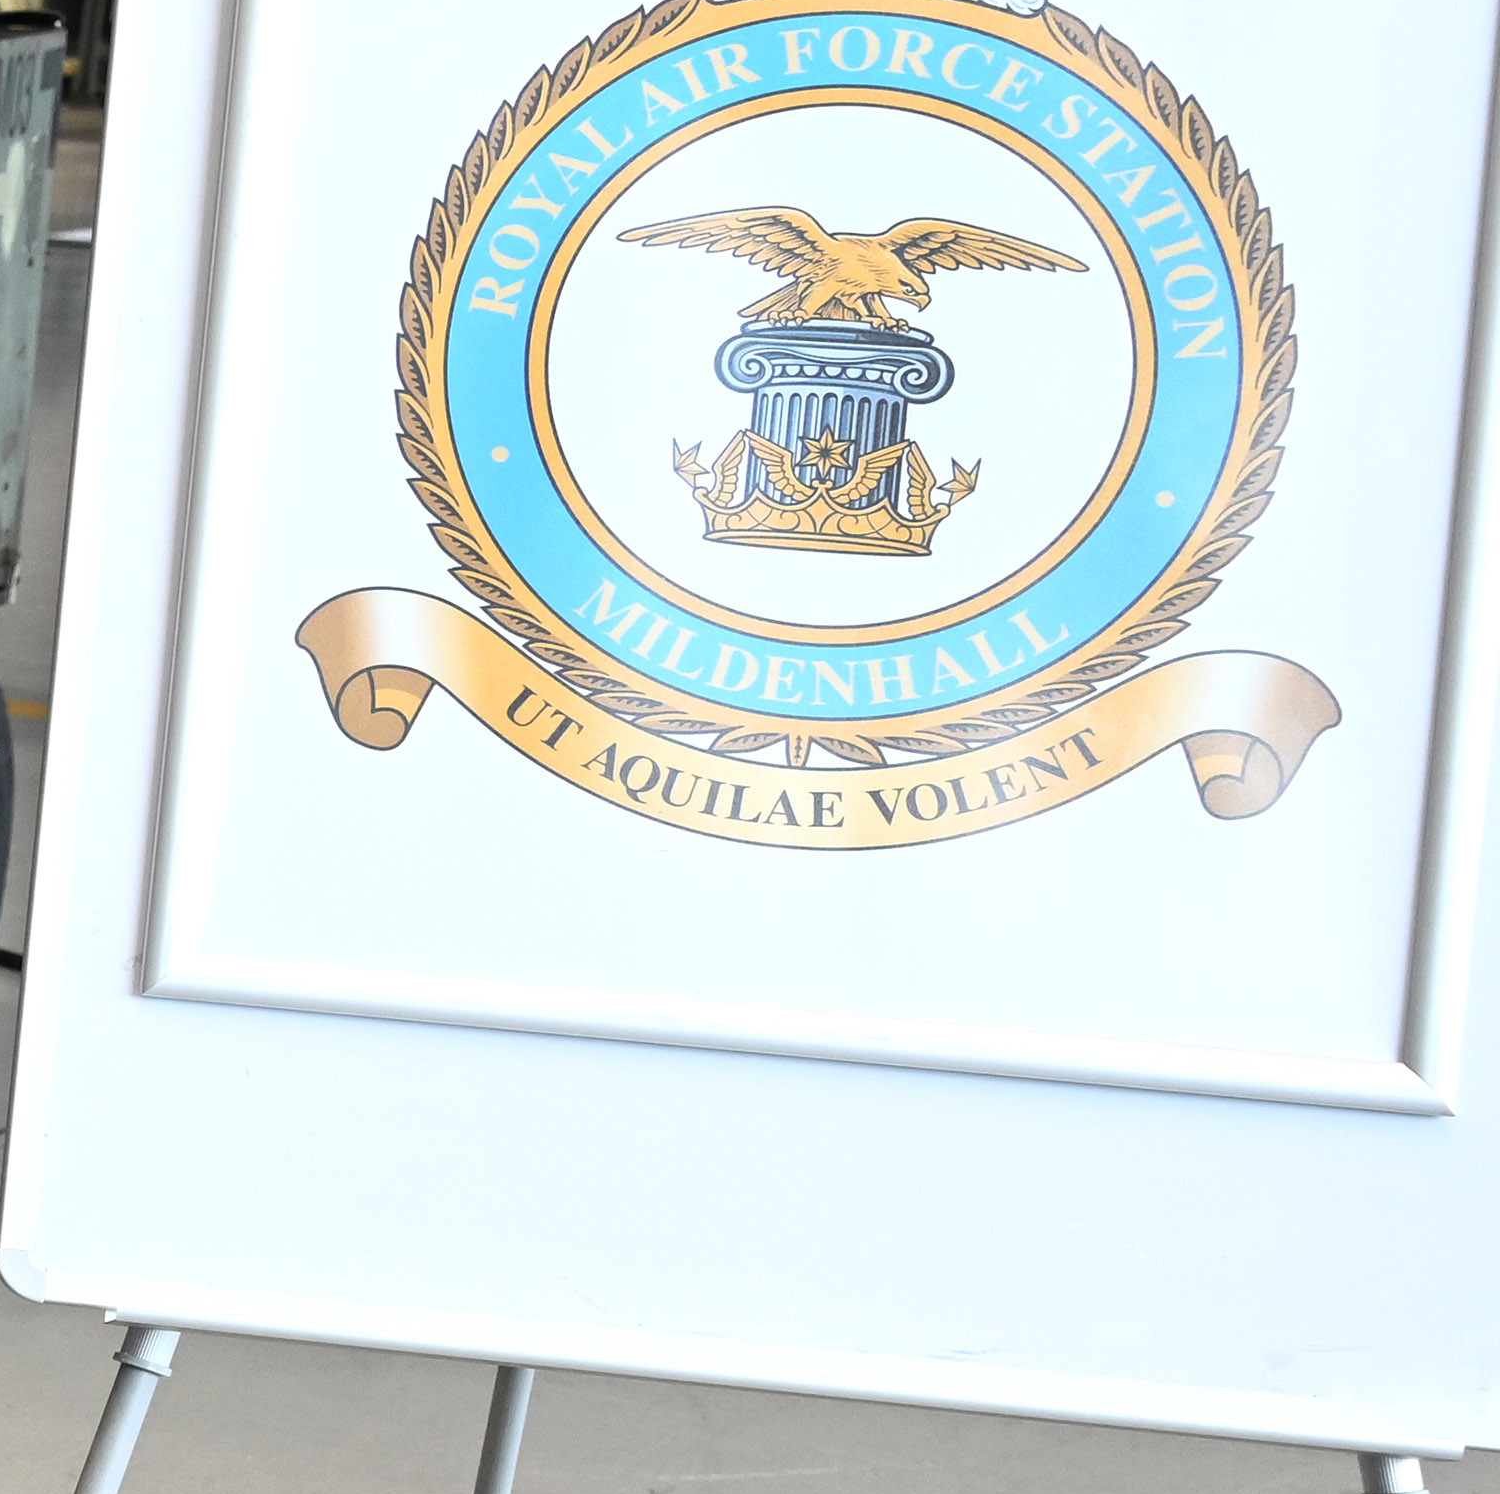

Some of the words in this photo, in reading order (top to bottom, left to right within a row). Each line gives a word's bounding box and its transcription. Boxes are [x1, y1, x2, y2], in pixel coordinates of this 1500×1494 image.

[467, 116, 634, 320] ROYAL
[641, 43, 762, 128] AIR
[778, 25, 1044, 112] FORCE
[1040, 93, 1228, 360] STATION
[574, 577, 1070, 707] MILDENHALL
[505, 685, 584, 752] UT
[581, 741, 845, 829] AQUILAE
[865, 726, 1105, 827] VOLENT
